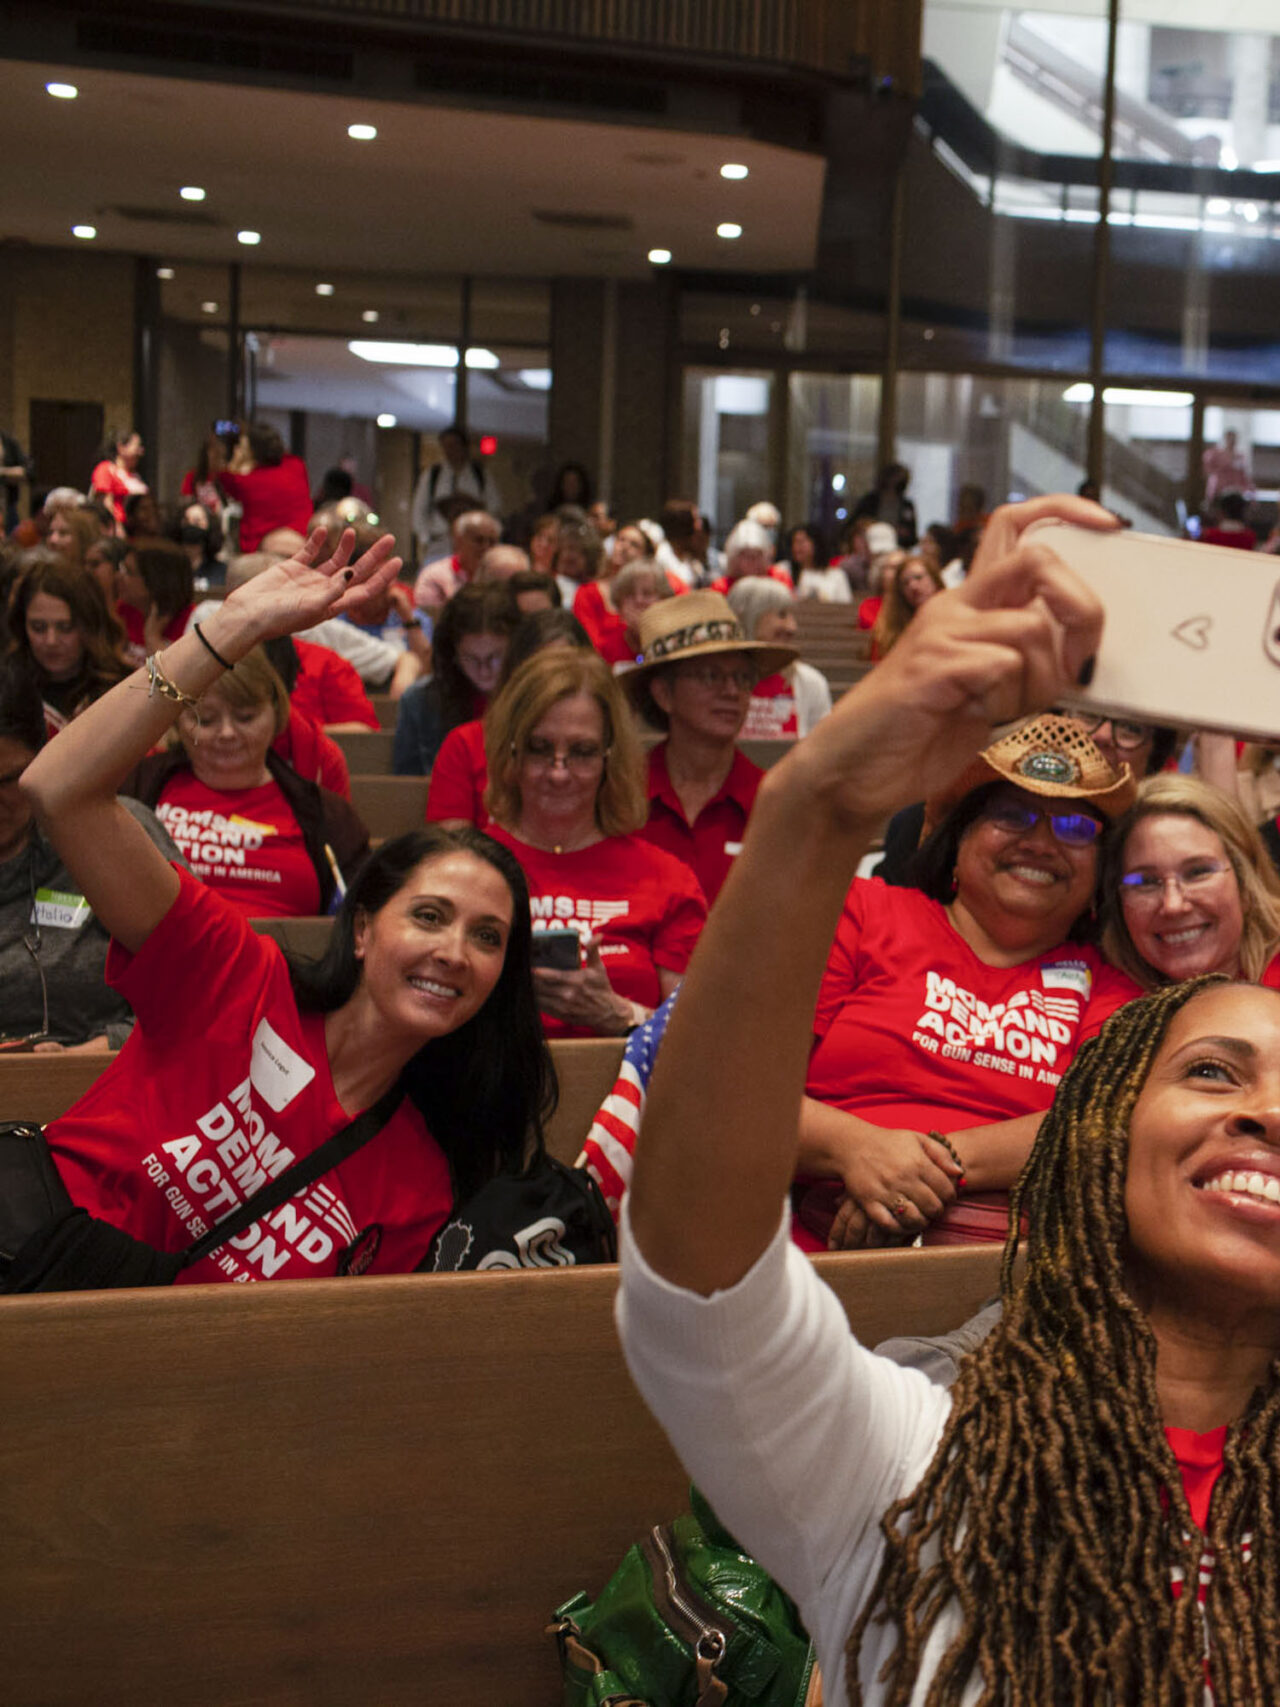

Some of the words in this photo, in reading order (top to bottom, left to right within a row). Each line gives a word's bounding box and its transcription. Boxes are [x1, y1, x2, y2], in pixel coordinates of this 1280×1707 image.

[174, 839, 245, 866] TION
[213, 864, 227, 877] IN
[229, 866, 282, 883] AMERICA
[530, 895, 575, 919] MS
[917, 1011, 1057, 1067] ACTION
[925, 990, 1071, 1045] DEMAND
[912, 1031, 939, 1054] FOR
[942, 1043, 972, 1062] GUN
[973, 1051, 1016, 1075] SENSE
[1019, 1065, 1034, 1080] IN
[197, 1102, 333, 1264] DEMND
[142, 1153, 171, 1188] FOR
[165, 1184, 194, 1220] GUN
[186, 1215, 224, 1260] SEE
[218, 1253, 240, 1276] IN
